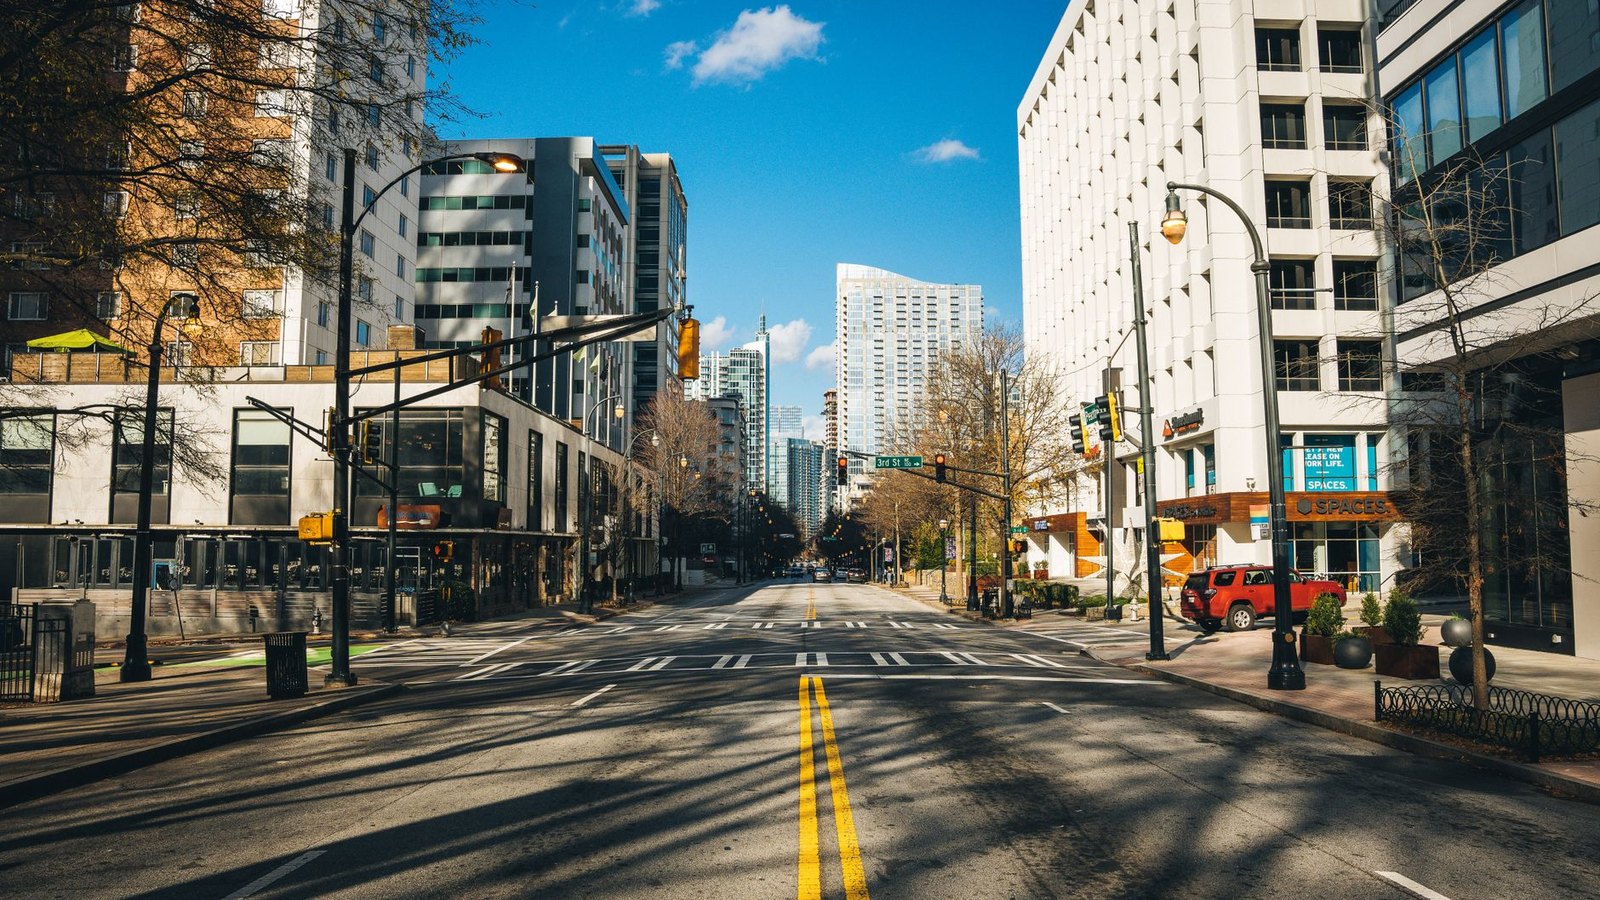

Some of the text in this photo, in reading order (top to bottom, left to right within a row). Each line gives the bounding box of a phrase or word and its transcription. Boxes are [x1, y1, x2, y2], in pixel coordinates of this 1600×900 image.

[877, 458, 890, 467] 3rd
[892, 458, 901, 467] St
[1308, 481, 1348, 489] SPACES.
[1316, 498, 1390, 514] SPACES.
